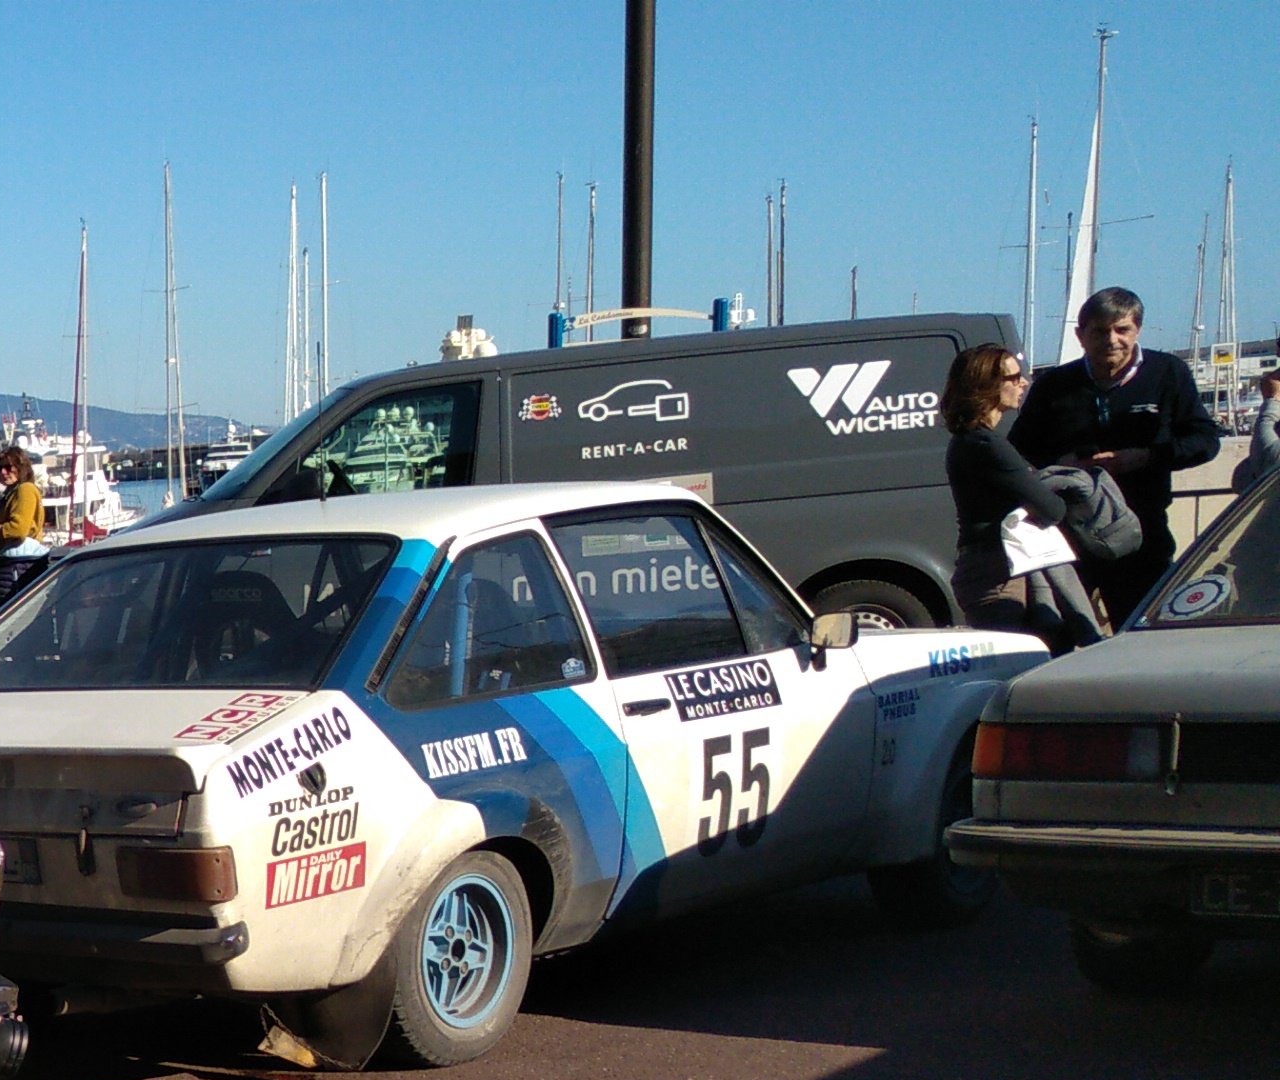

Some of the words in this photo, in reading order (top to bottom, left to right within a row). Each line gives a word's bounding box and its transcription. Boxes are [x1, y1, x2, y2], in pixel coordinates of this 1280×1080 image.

[865, 391, 939, 414] AUTO
[825, 410, 939, 435] WICHERT
[581, 437, 689, 460] RENT-A-CAR
[668, 675, 696, 701] LE
[694, 662, 771, 697] CASINO
[226, 706, 352, 799] MONTE-CARLO
[421, 726, 528, 779] KISSFM.FR
[268, 785, 355, 817] DUNLOP
[697, 726, 771, 857] 55
[271, 801, 360, 857] Castrol
[309, 849, 344, 866] DAILY
[270, 853, 362, 907] Mirror
